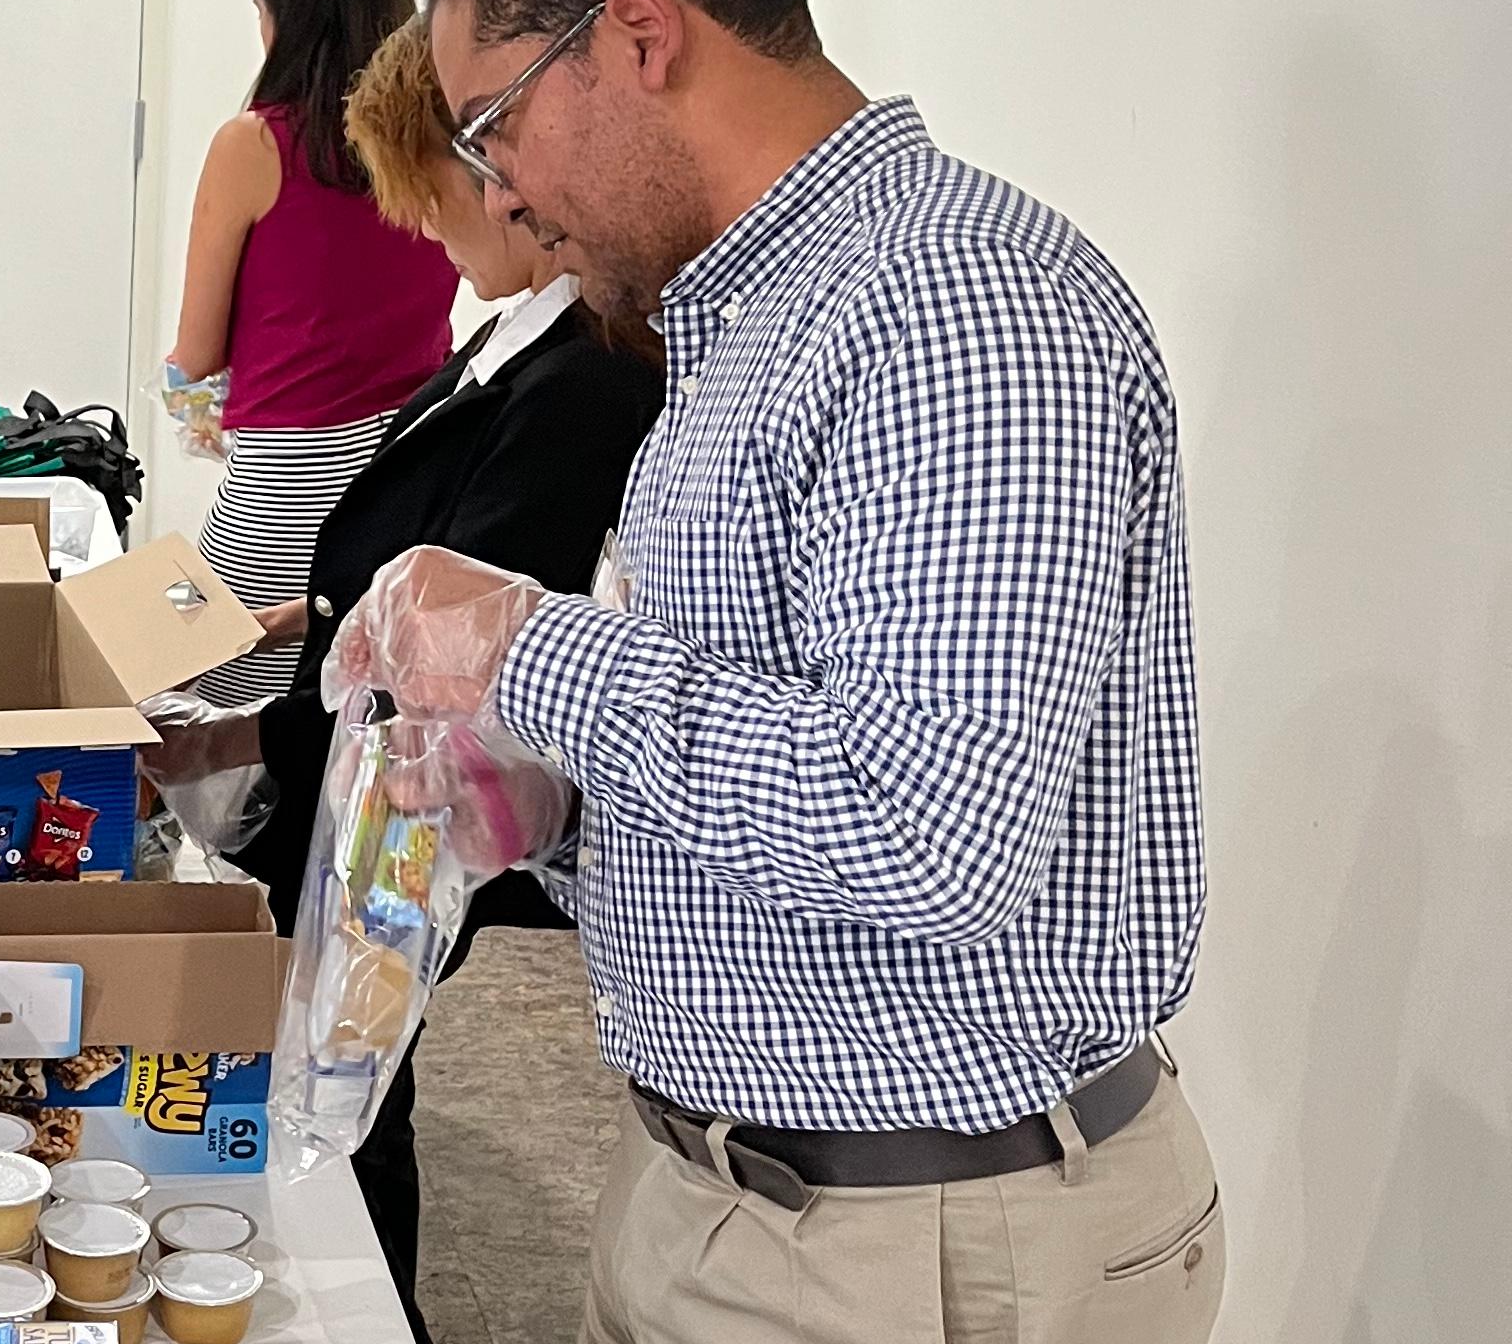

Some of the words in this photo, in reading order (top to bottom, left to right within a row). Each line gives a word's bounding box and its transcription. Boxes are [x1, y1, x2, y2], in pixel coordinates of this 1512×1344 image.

[43, 822, 81, 840] Doritos
[133, 1065, 149, 1108] SUGAR
[208, 1128, 217, 1153] BARS
[218, 1116, 229, 1163] GRANOLA
[228, 1119, 258, 1160] 60
